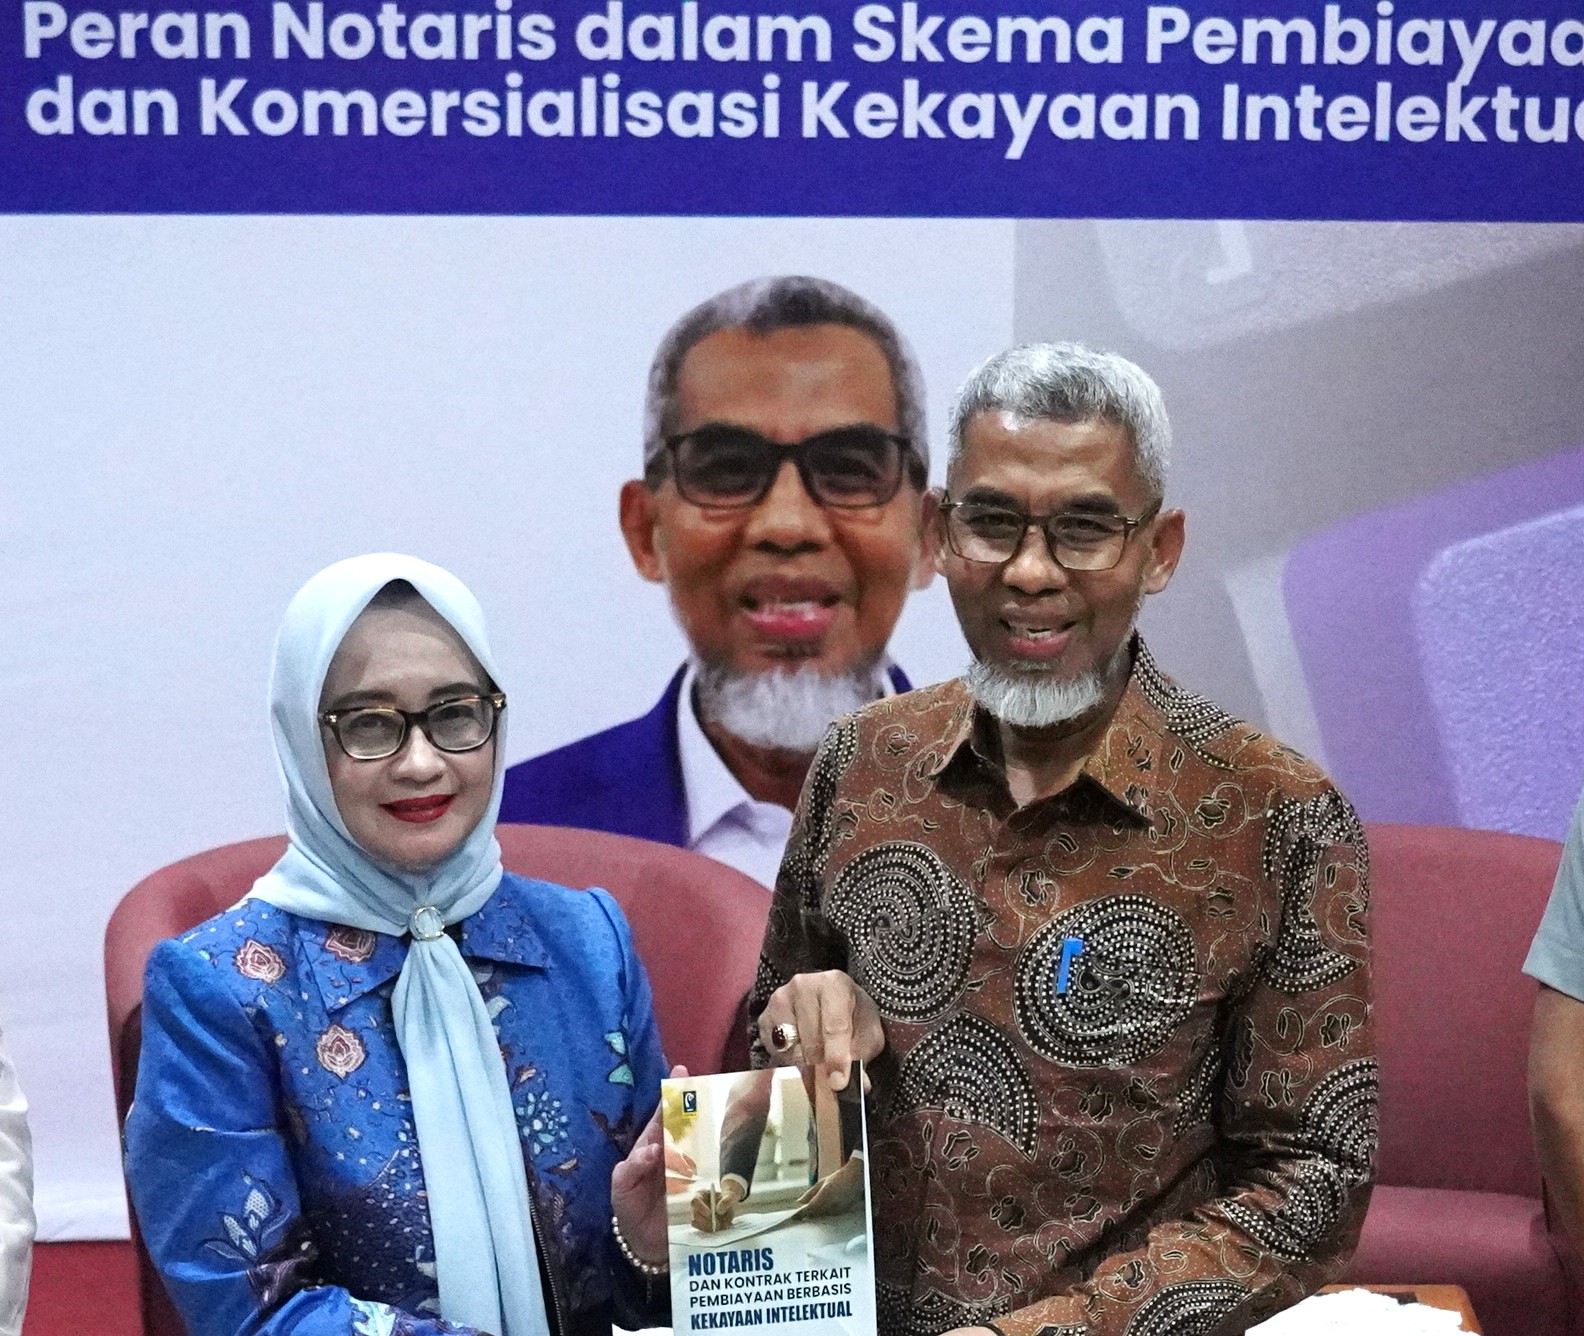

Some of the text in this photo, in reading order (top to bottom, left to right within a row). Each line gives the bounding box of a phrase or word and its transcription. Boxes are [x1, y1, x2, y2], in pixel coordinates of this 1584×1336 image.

[23, 2, 252, 61] Peran
[272, 0, 557, 61] Notaris
[574, 0, 833, 63] dalam
[852, 0, 1125, 64] Skema
[24, 74, 179, 136] dan
[200, 72, 781, 138] Komersialisasi
[801, 78, 1200, 160] Kekayaan
[688, 1247, 774, 1277] NOTARIS
[689, 1266, 852, 1292] DAN KONTRAK TERKAIT
[690, 1282, 852, 1309] PEMBIAYAAN BERBASIS
[691, 1300, 853, 1331] KEKAYAAN INTELEKTUAL
